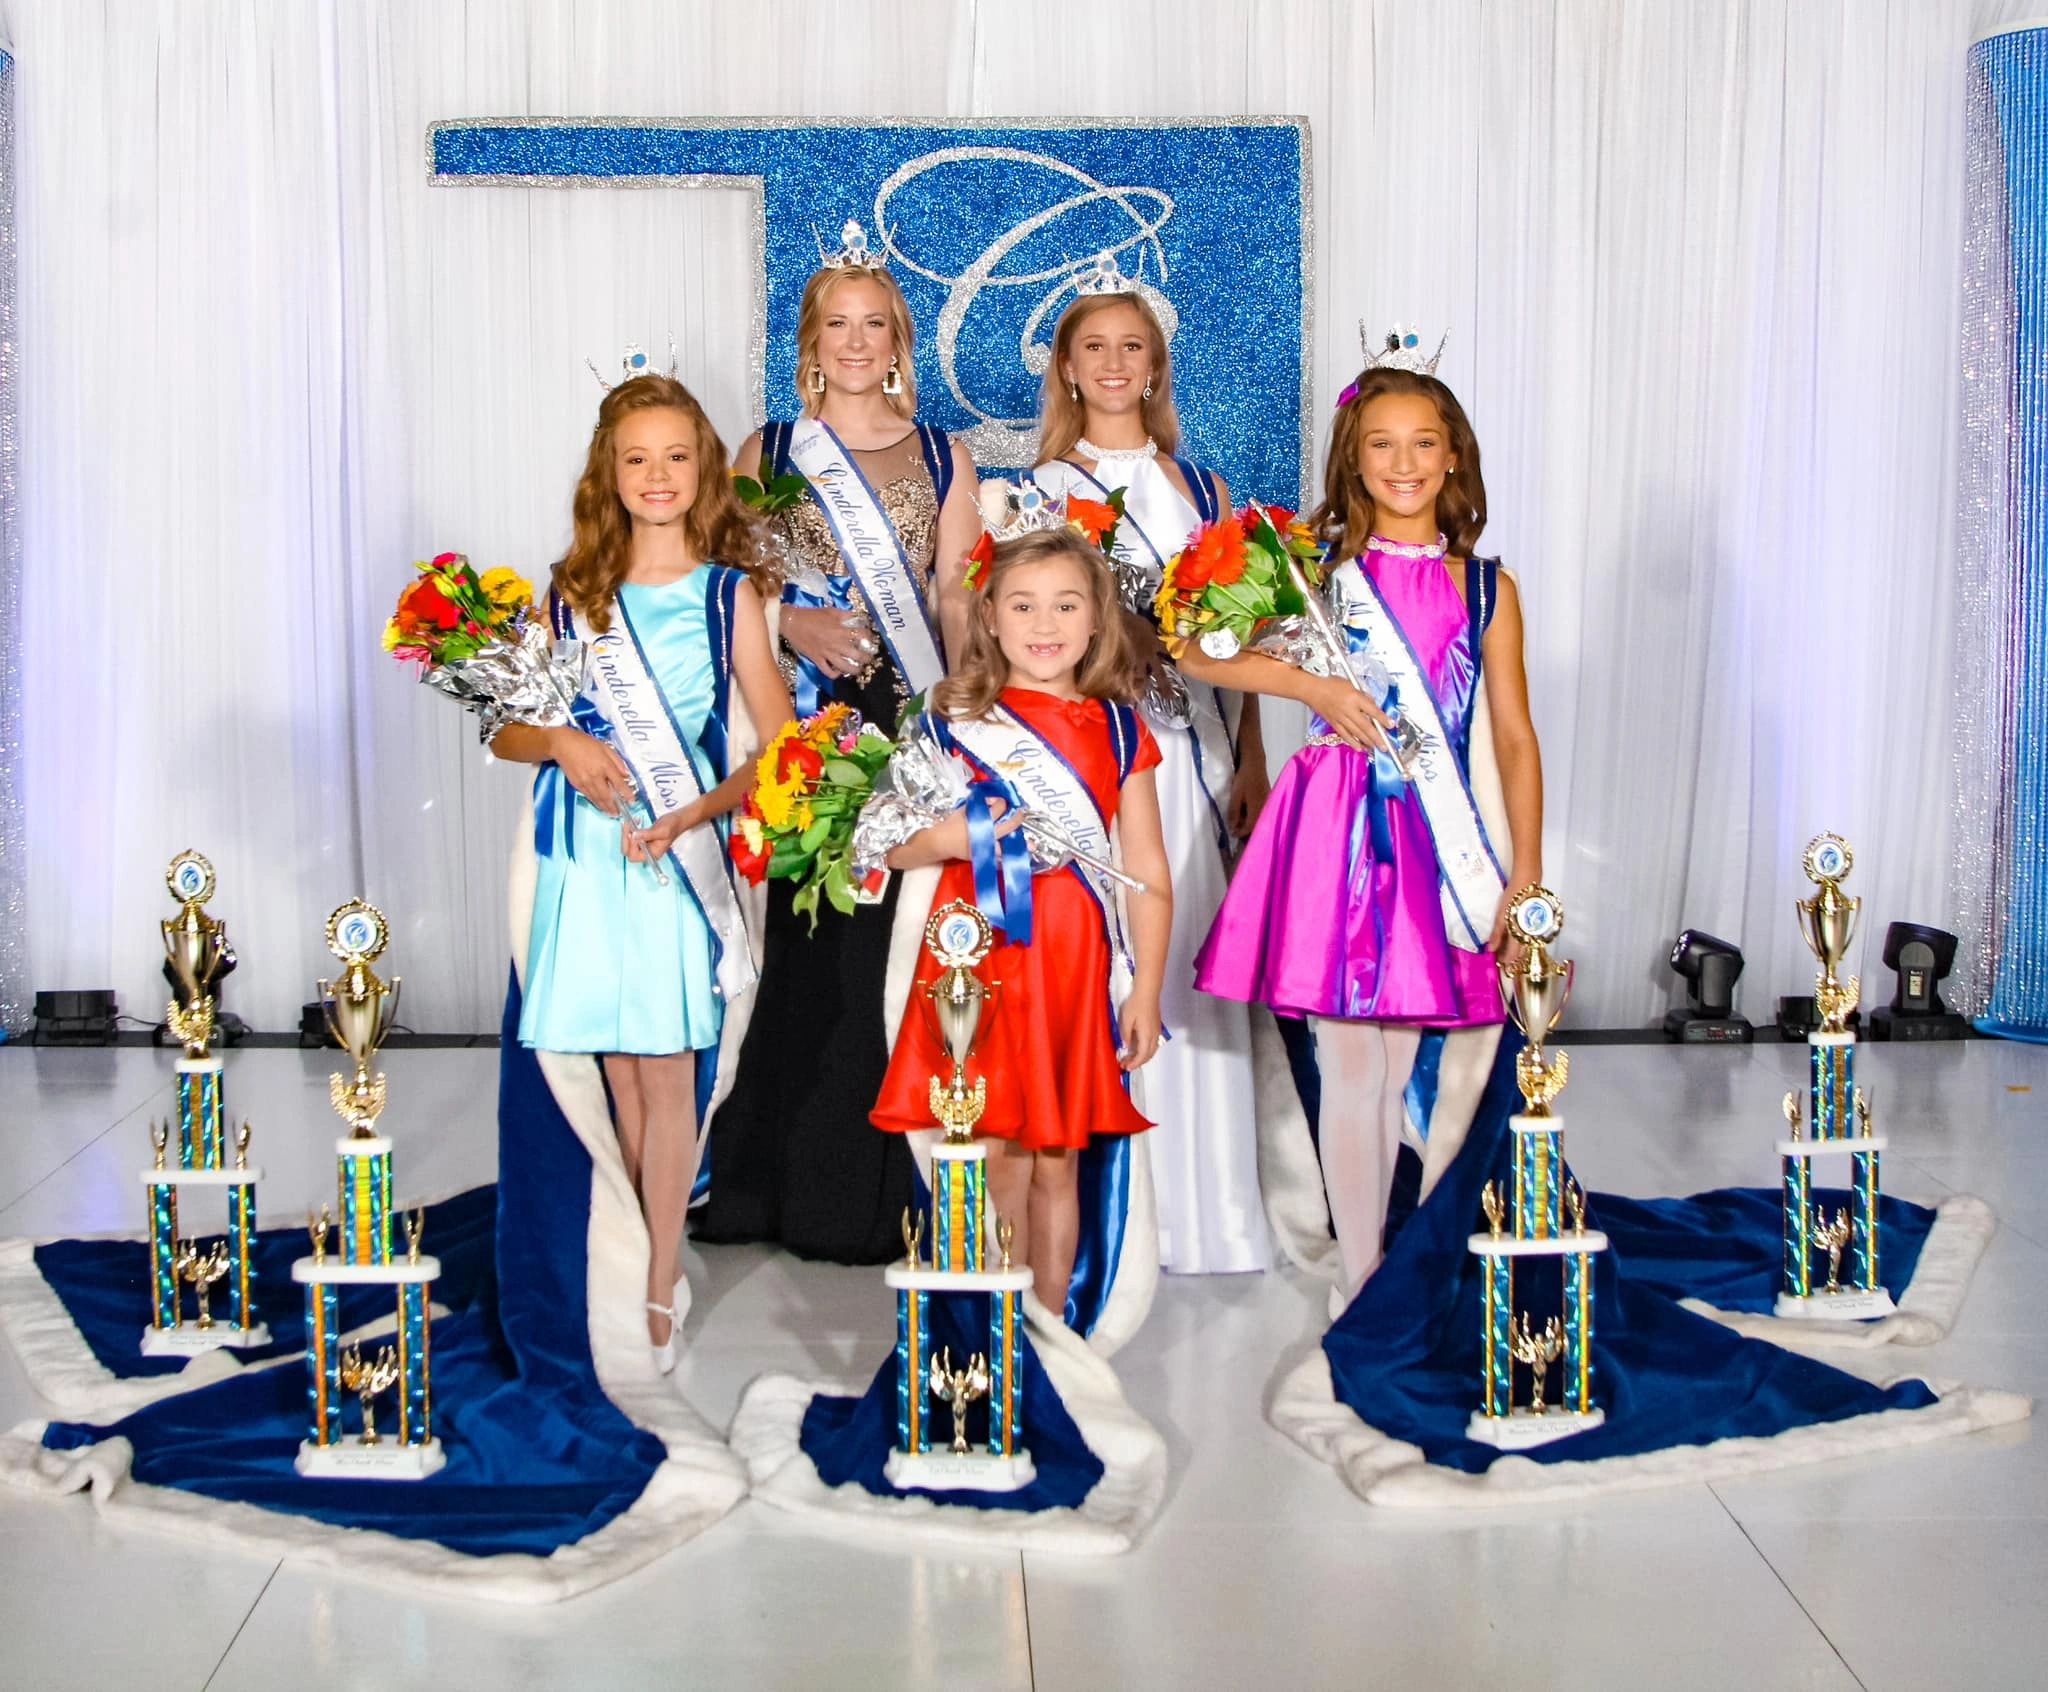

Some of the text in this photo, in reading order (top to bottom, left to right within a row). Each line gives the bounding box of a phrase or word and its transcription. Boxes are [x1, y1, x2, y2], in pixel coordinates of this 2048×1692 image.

[818, 461, 907, 632] Cinderella Woman
[593, 626, 685, 809] Cinderella Miss
[1006, 739, 1099, 853] Cinderella
